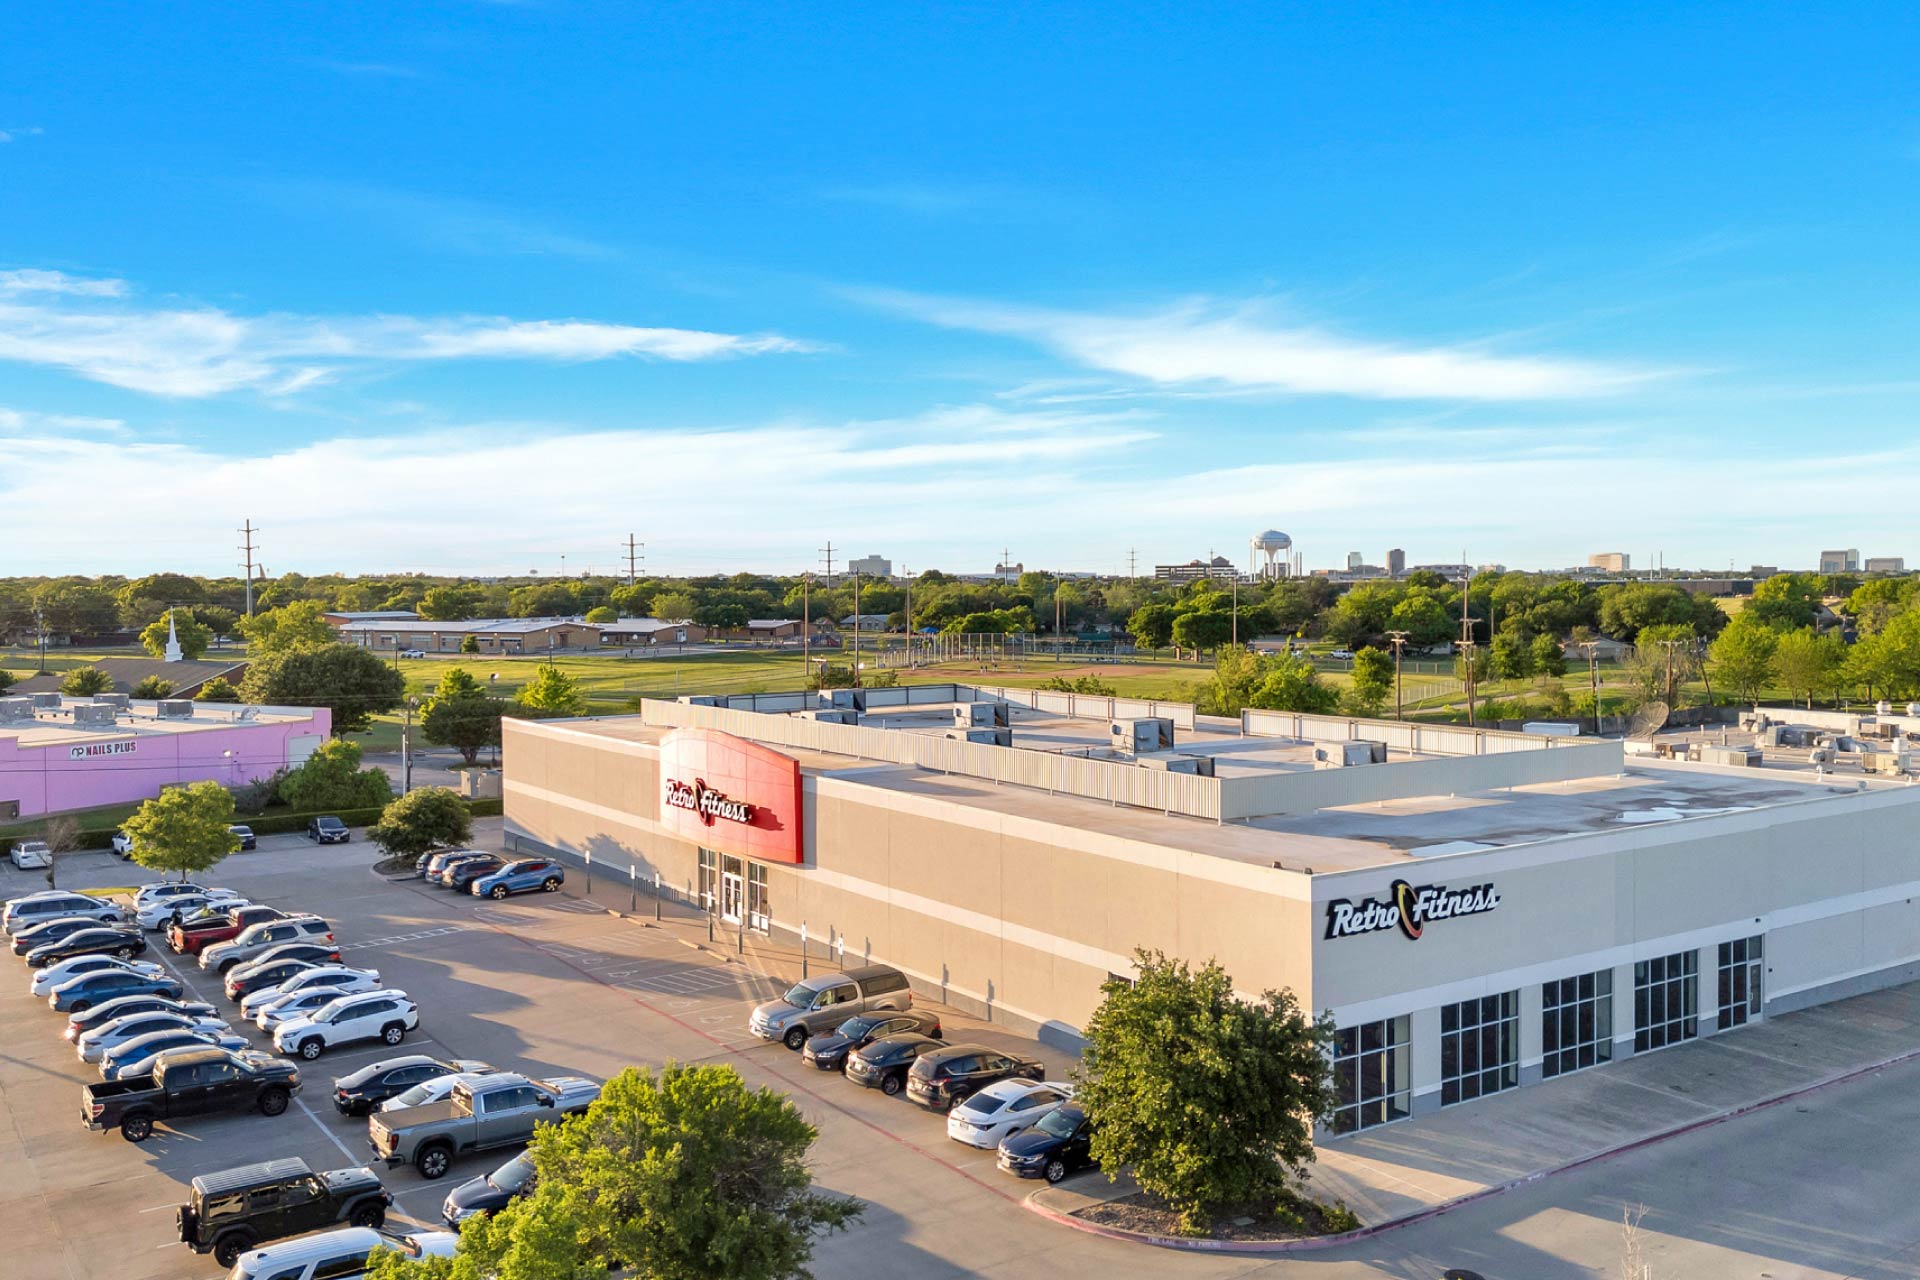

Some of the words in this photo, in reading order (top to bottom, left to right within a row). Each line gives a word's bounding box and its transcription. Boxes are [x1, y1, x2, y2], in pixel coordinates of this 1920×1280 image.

[86, 744, 112, 756] NAILS
[114, 742, 136, 753] PLUS
[665, 782, 695, 808] Retro
[700, 789, 749, 822] Fitness
[1332, 903, 1400, 936] Retro
[1412, 888, 1500, 922] Fitness
